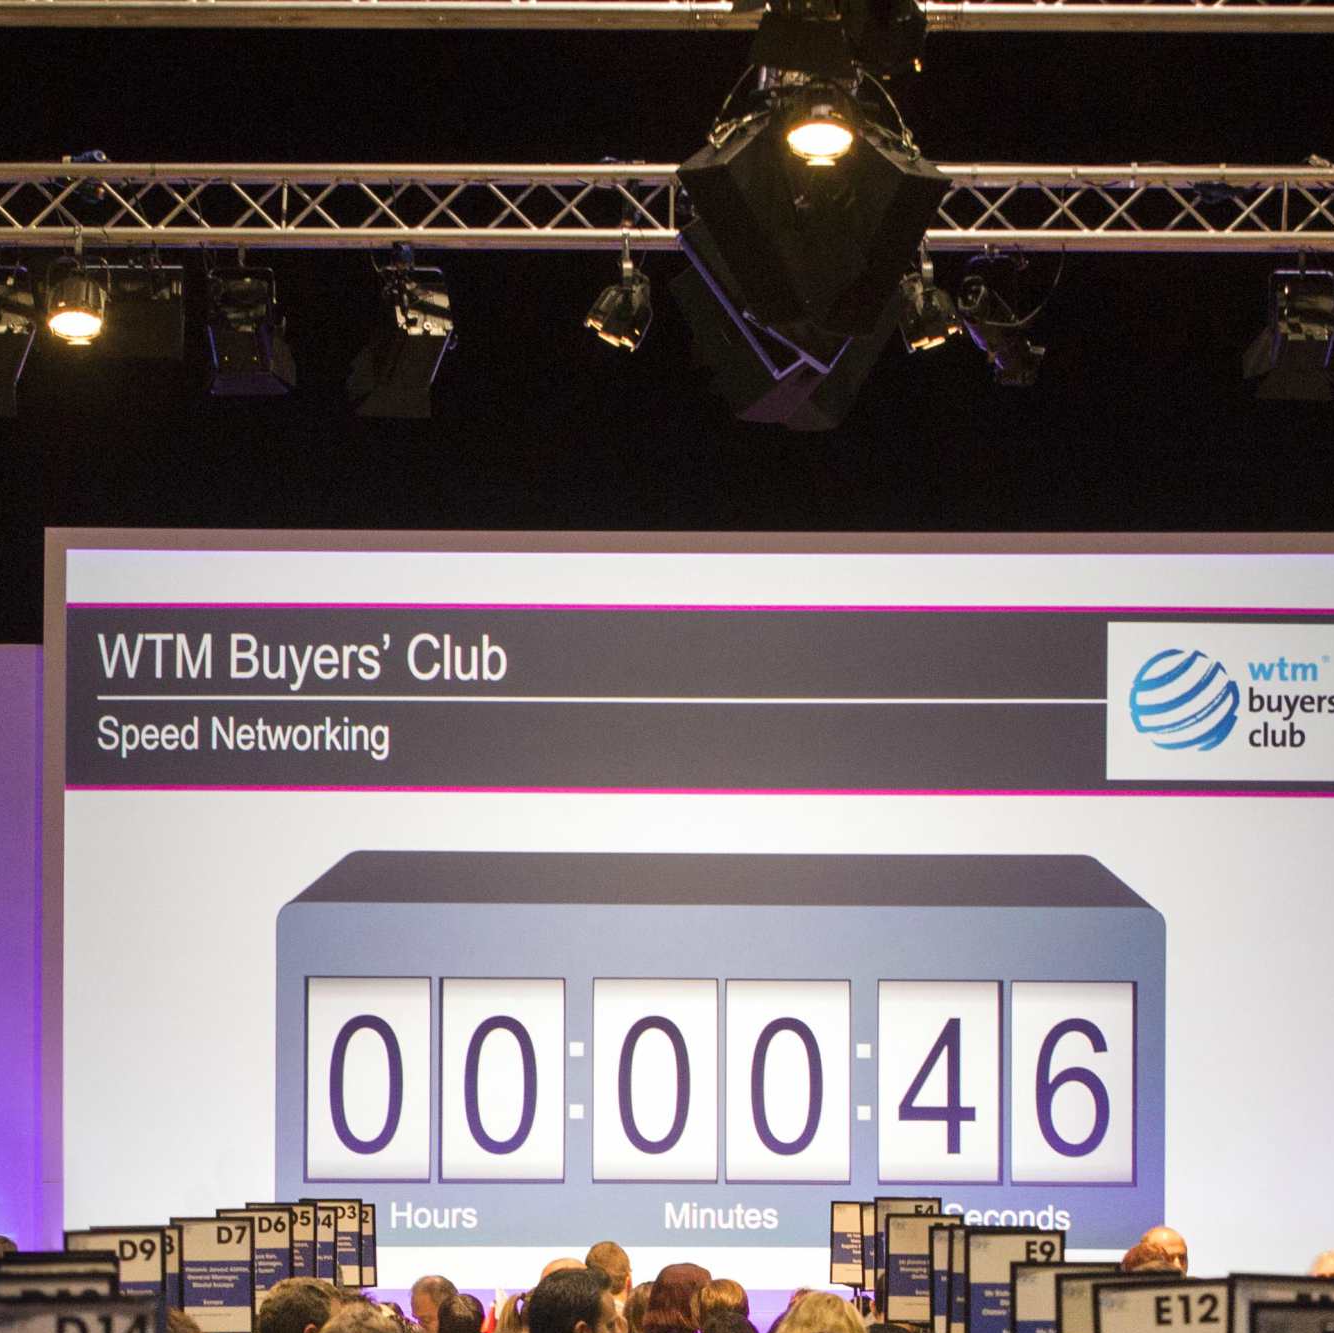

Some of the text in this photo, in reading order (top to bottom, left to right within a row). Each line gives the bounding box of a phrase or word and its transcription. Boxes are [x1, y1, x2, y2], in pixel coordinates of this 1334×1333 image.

[97, 633, 213, 680] WTM
[406, 633, 508, 681] Club
[97, 716, 390, 760] Speed Networking
[1248, 721, 1306, 748] club
[258, 1216, 286, 1233] D6
[337, 1206, 356, 1220] D3
[390, 1202, 478, 1230] Hours
[664, 1203, 779, 1231] Minutes
[217, 1226, 247, 1245] D7
[118, 1239, 156, 1261] D9
[1025, 1241, 1056, 1262] E9
[1154, 1293, 1219, 1326] E12
